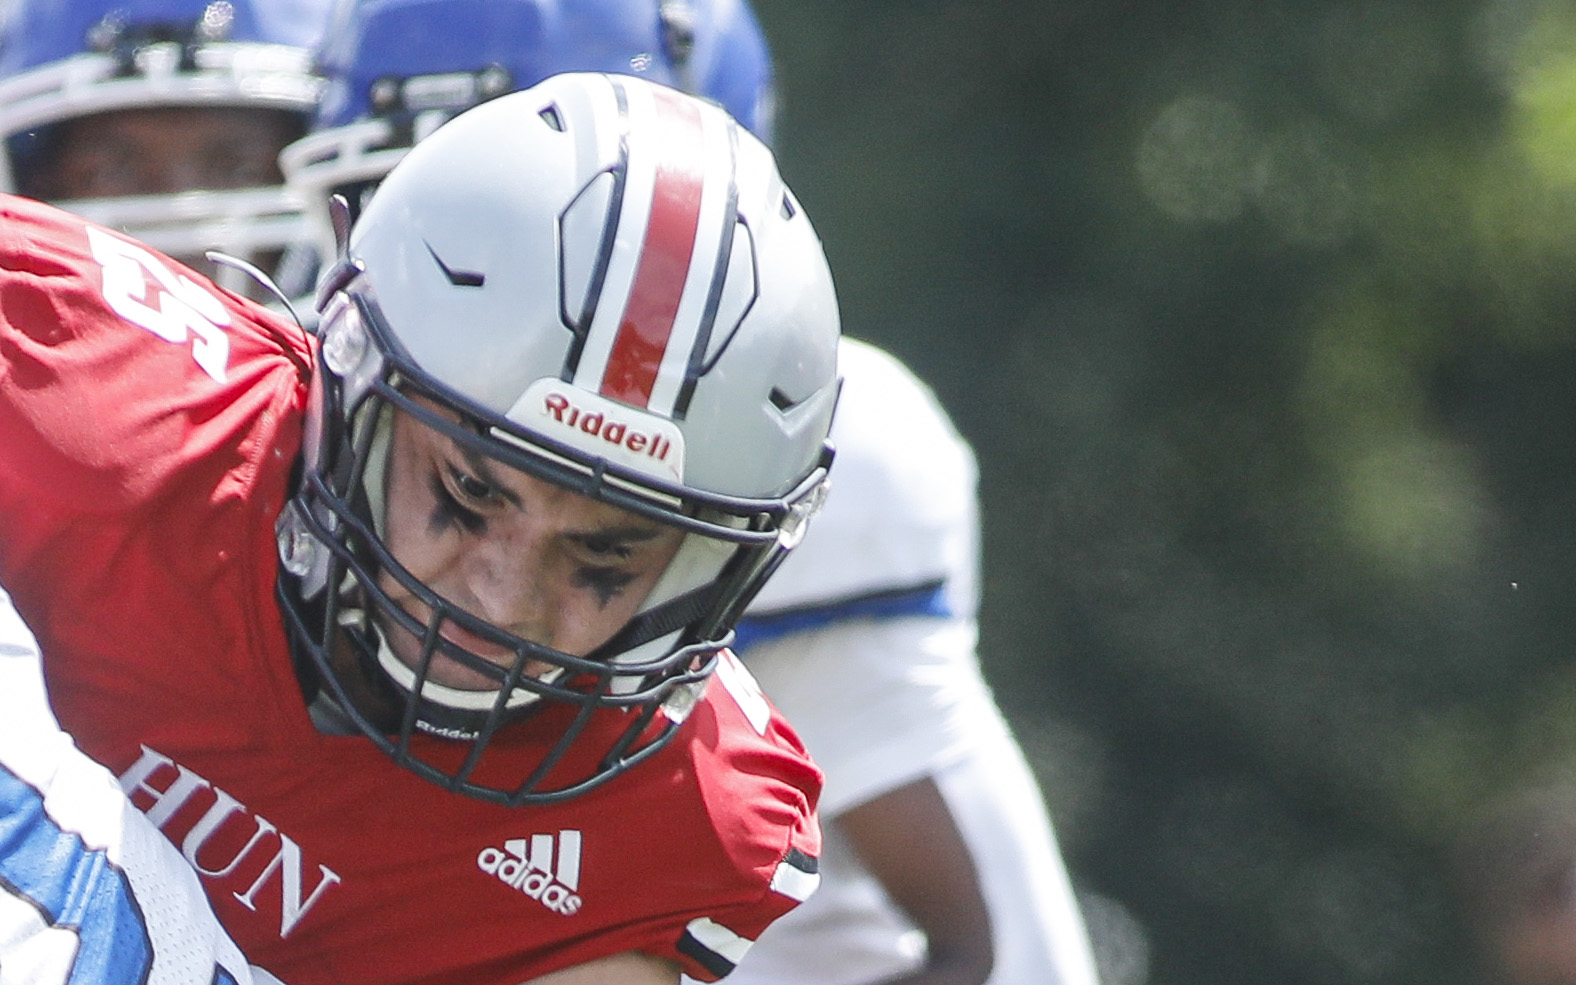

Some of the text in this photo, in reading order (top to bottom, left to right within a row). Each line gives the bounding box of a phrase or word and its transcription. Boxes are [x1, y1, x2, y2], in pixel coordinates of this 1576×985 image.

[545, 393, 670, 461] Riddell
[415, 719, 480, 740] Riddel
[119, 743, 343, 939] HUN
[477, 847, 583, 915] adidas
